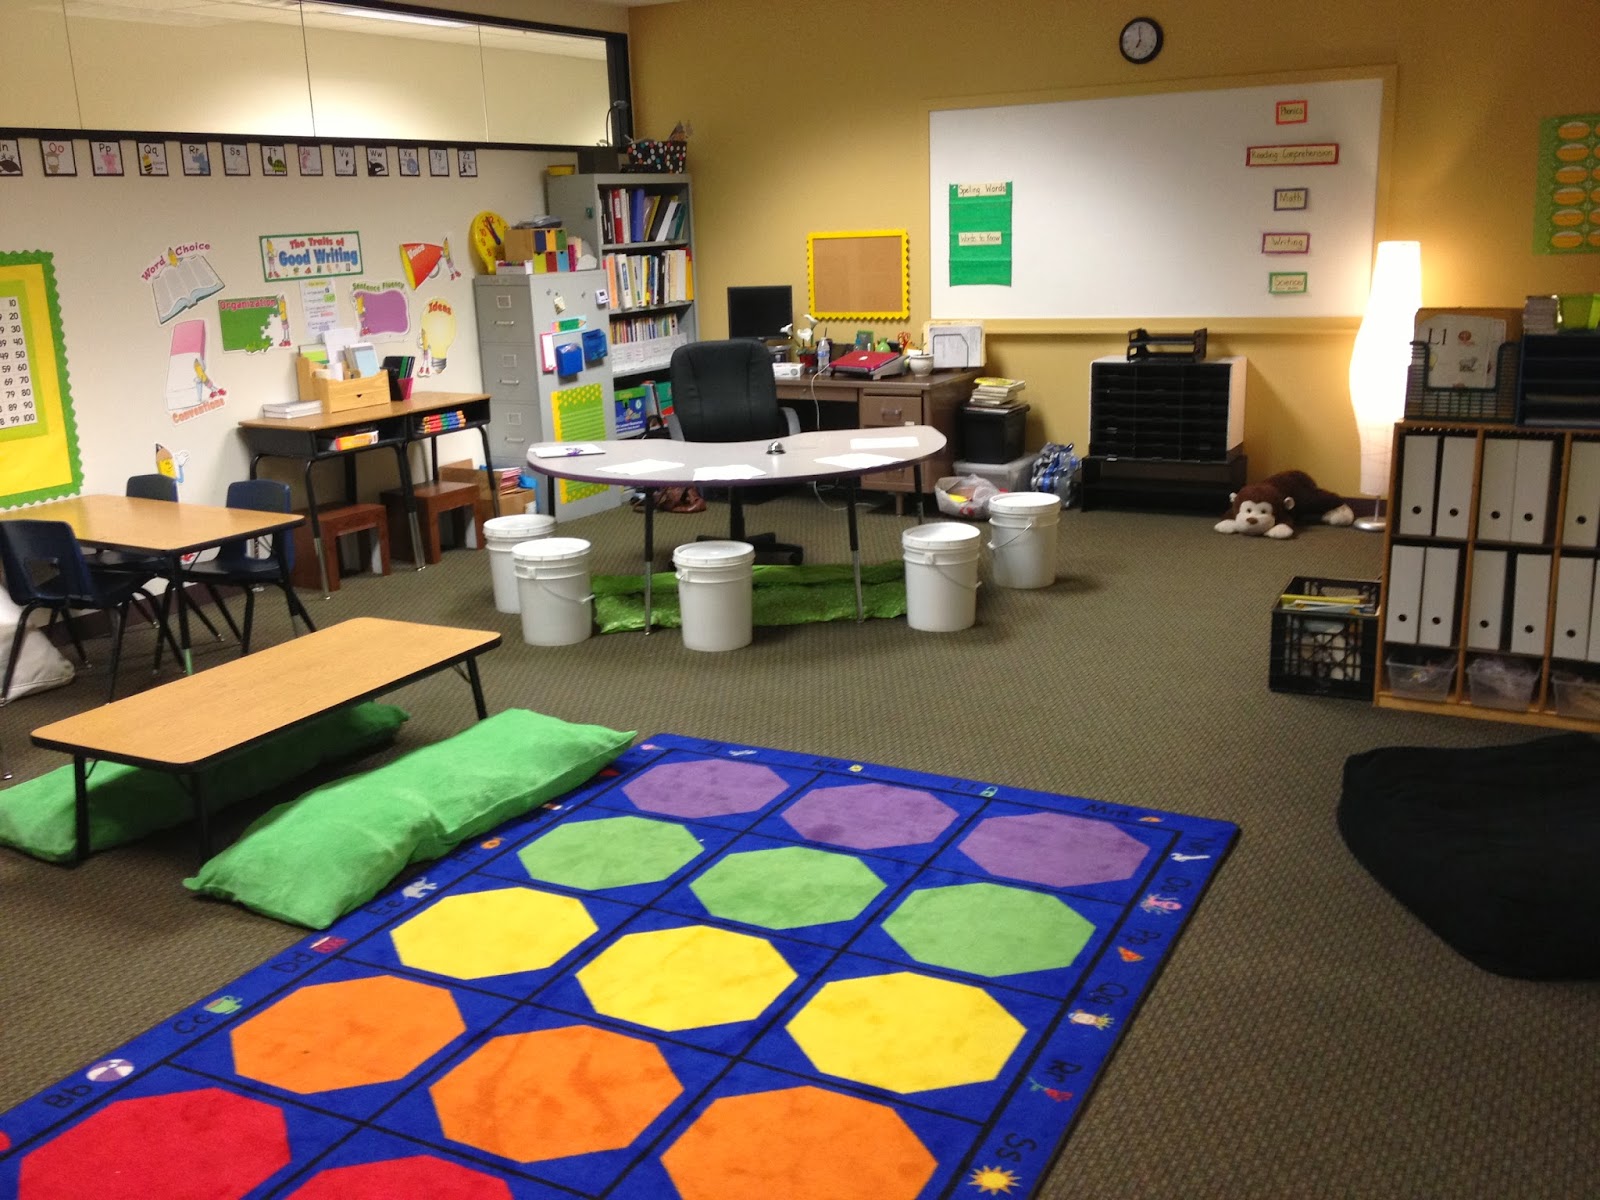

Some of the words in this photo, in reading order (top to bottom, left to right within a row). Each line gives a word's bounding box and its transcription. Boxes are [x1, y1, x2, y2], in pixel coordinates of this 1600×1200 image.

[985, 184, 1006, 193] Words
[1279, 191, 1302, 202] Math
[289, 239, 306, 249] The
[308, 236, 333, 247] Traits
[336, 237, 345, 246] of
[1271, 237, 1303, 248] Writing
[141, 255, 166, 281] Word
[175, 242, 211, 256] Choice
[278, 249, 311, 266] Good
[313, 247, 358, 266] Writing
[352, 282, 380, 292] Sentence
[382, 281, 405, 290] Fluency
[219, 299, 277, 311] Organization
[428, 301, 452, 315] Ideas
[11, 325, 21, 333] 30
[13, 338, 23, 346] 40
[15, 351, 26, 359] 50
[2, 365, 11, 373] 59
[4, 378, 13, 386] 69
[19, 376, 29, 384] 70
[6, 390, 15, 398] 79
[21, 388, 31, 396] 80
[23, 401, 33, 409] 90
[172, 398, 225, 423] Conventions
[10, 416, 19, 424] 99
[23, 414, 35, 422] 100
[270, 951, 313, 974] Dd
[173, 1013, 214, 1035] Cc
[48, 1084, 92, 1109] Bb
